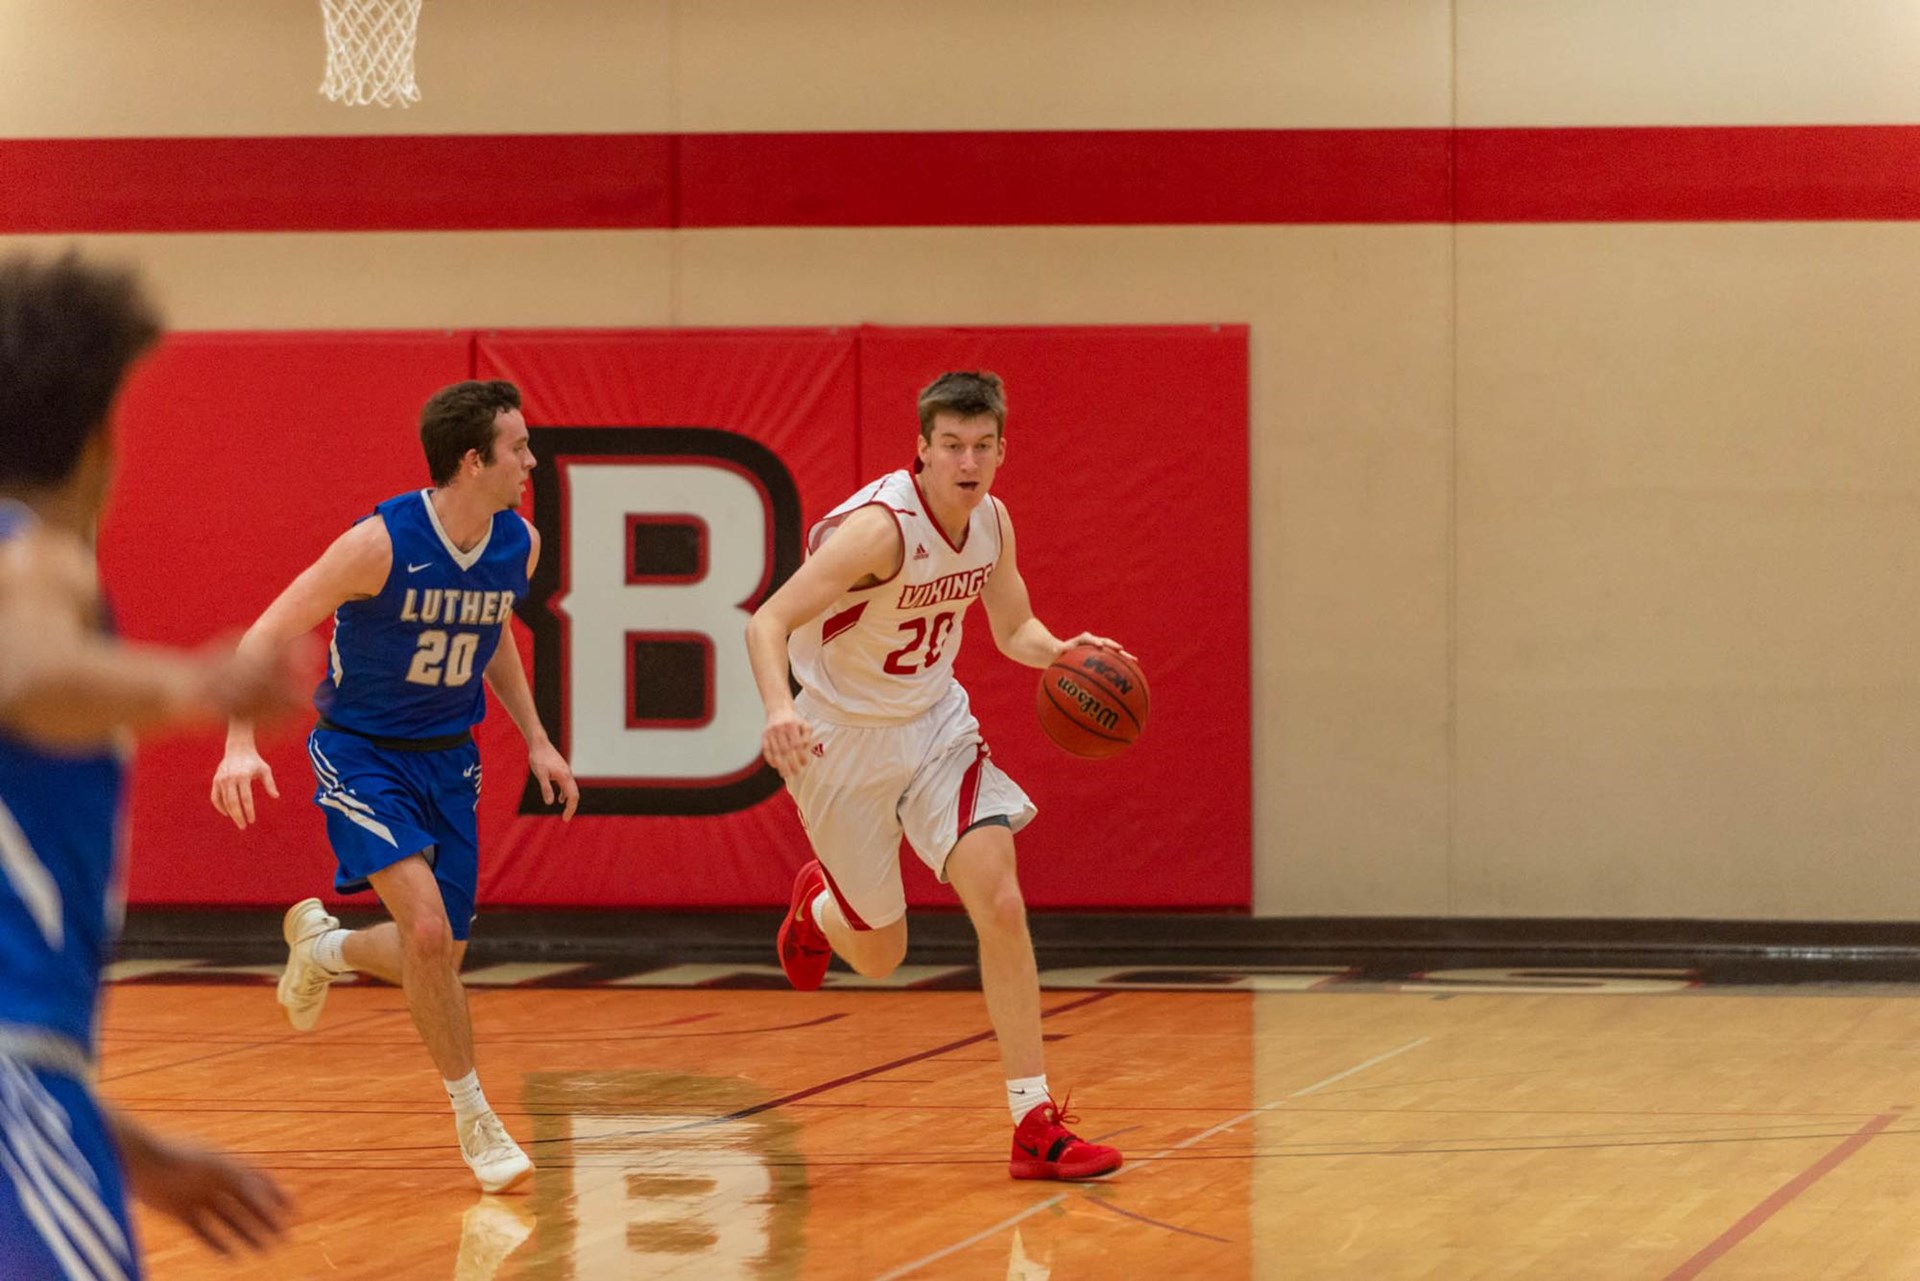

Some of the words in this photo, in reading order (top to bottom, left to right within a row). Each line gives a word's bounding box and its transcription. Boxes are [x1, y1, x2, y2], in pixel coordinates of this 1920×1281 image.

[400, 588, 516, 625] LUTHER
[518, 426, 803, 816] B
[405, 629, 480, 687] 20
[883, 611, 956, 675] 20
[1057, 676, 1119, 730] Wilson
